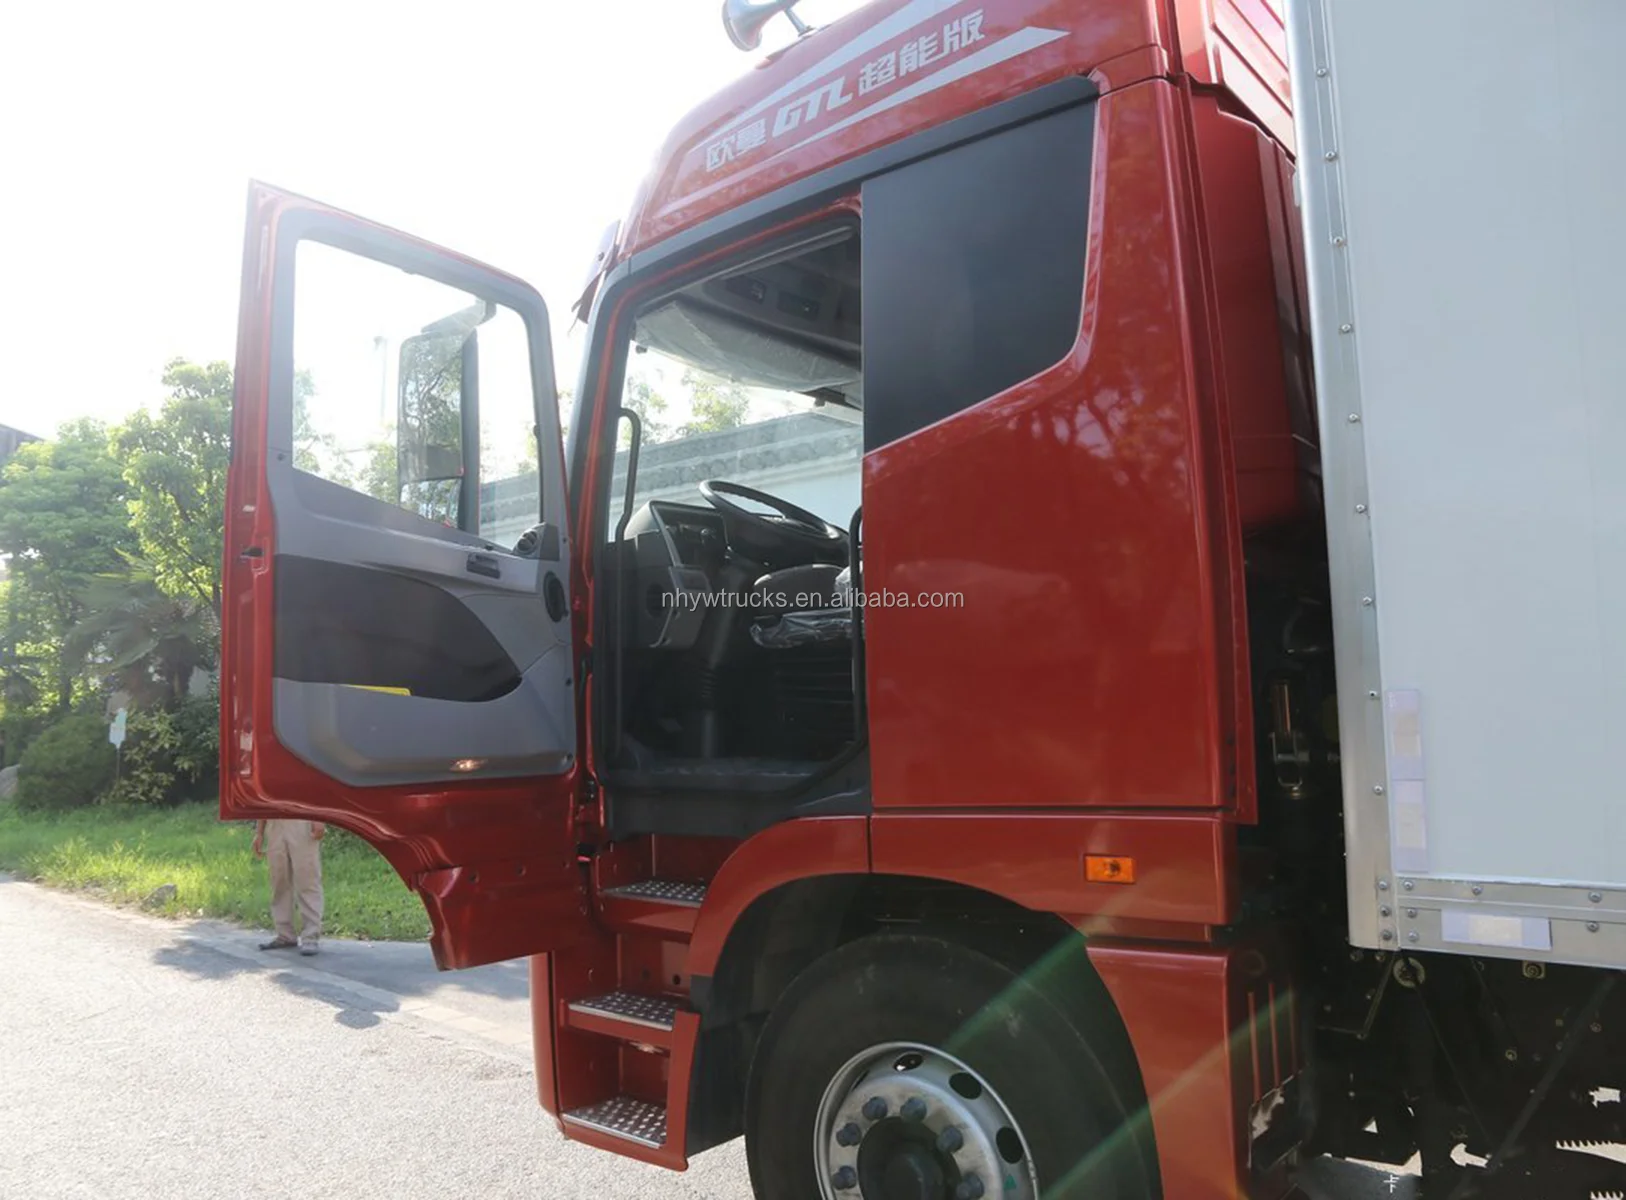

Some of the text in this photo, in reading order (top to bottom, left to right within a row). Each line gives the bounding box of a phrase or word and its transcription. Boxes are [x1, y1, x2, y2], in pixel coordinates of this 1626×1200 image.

[771, 75, 854, 138] GTL
[858, 8, 985, 97] 超能版
